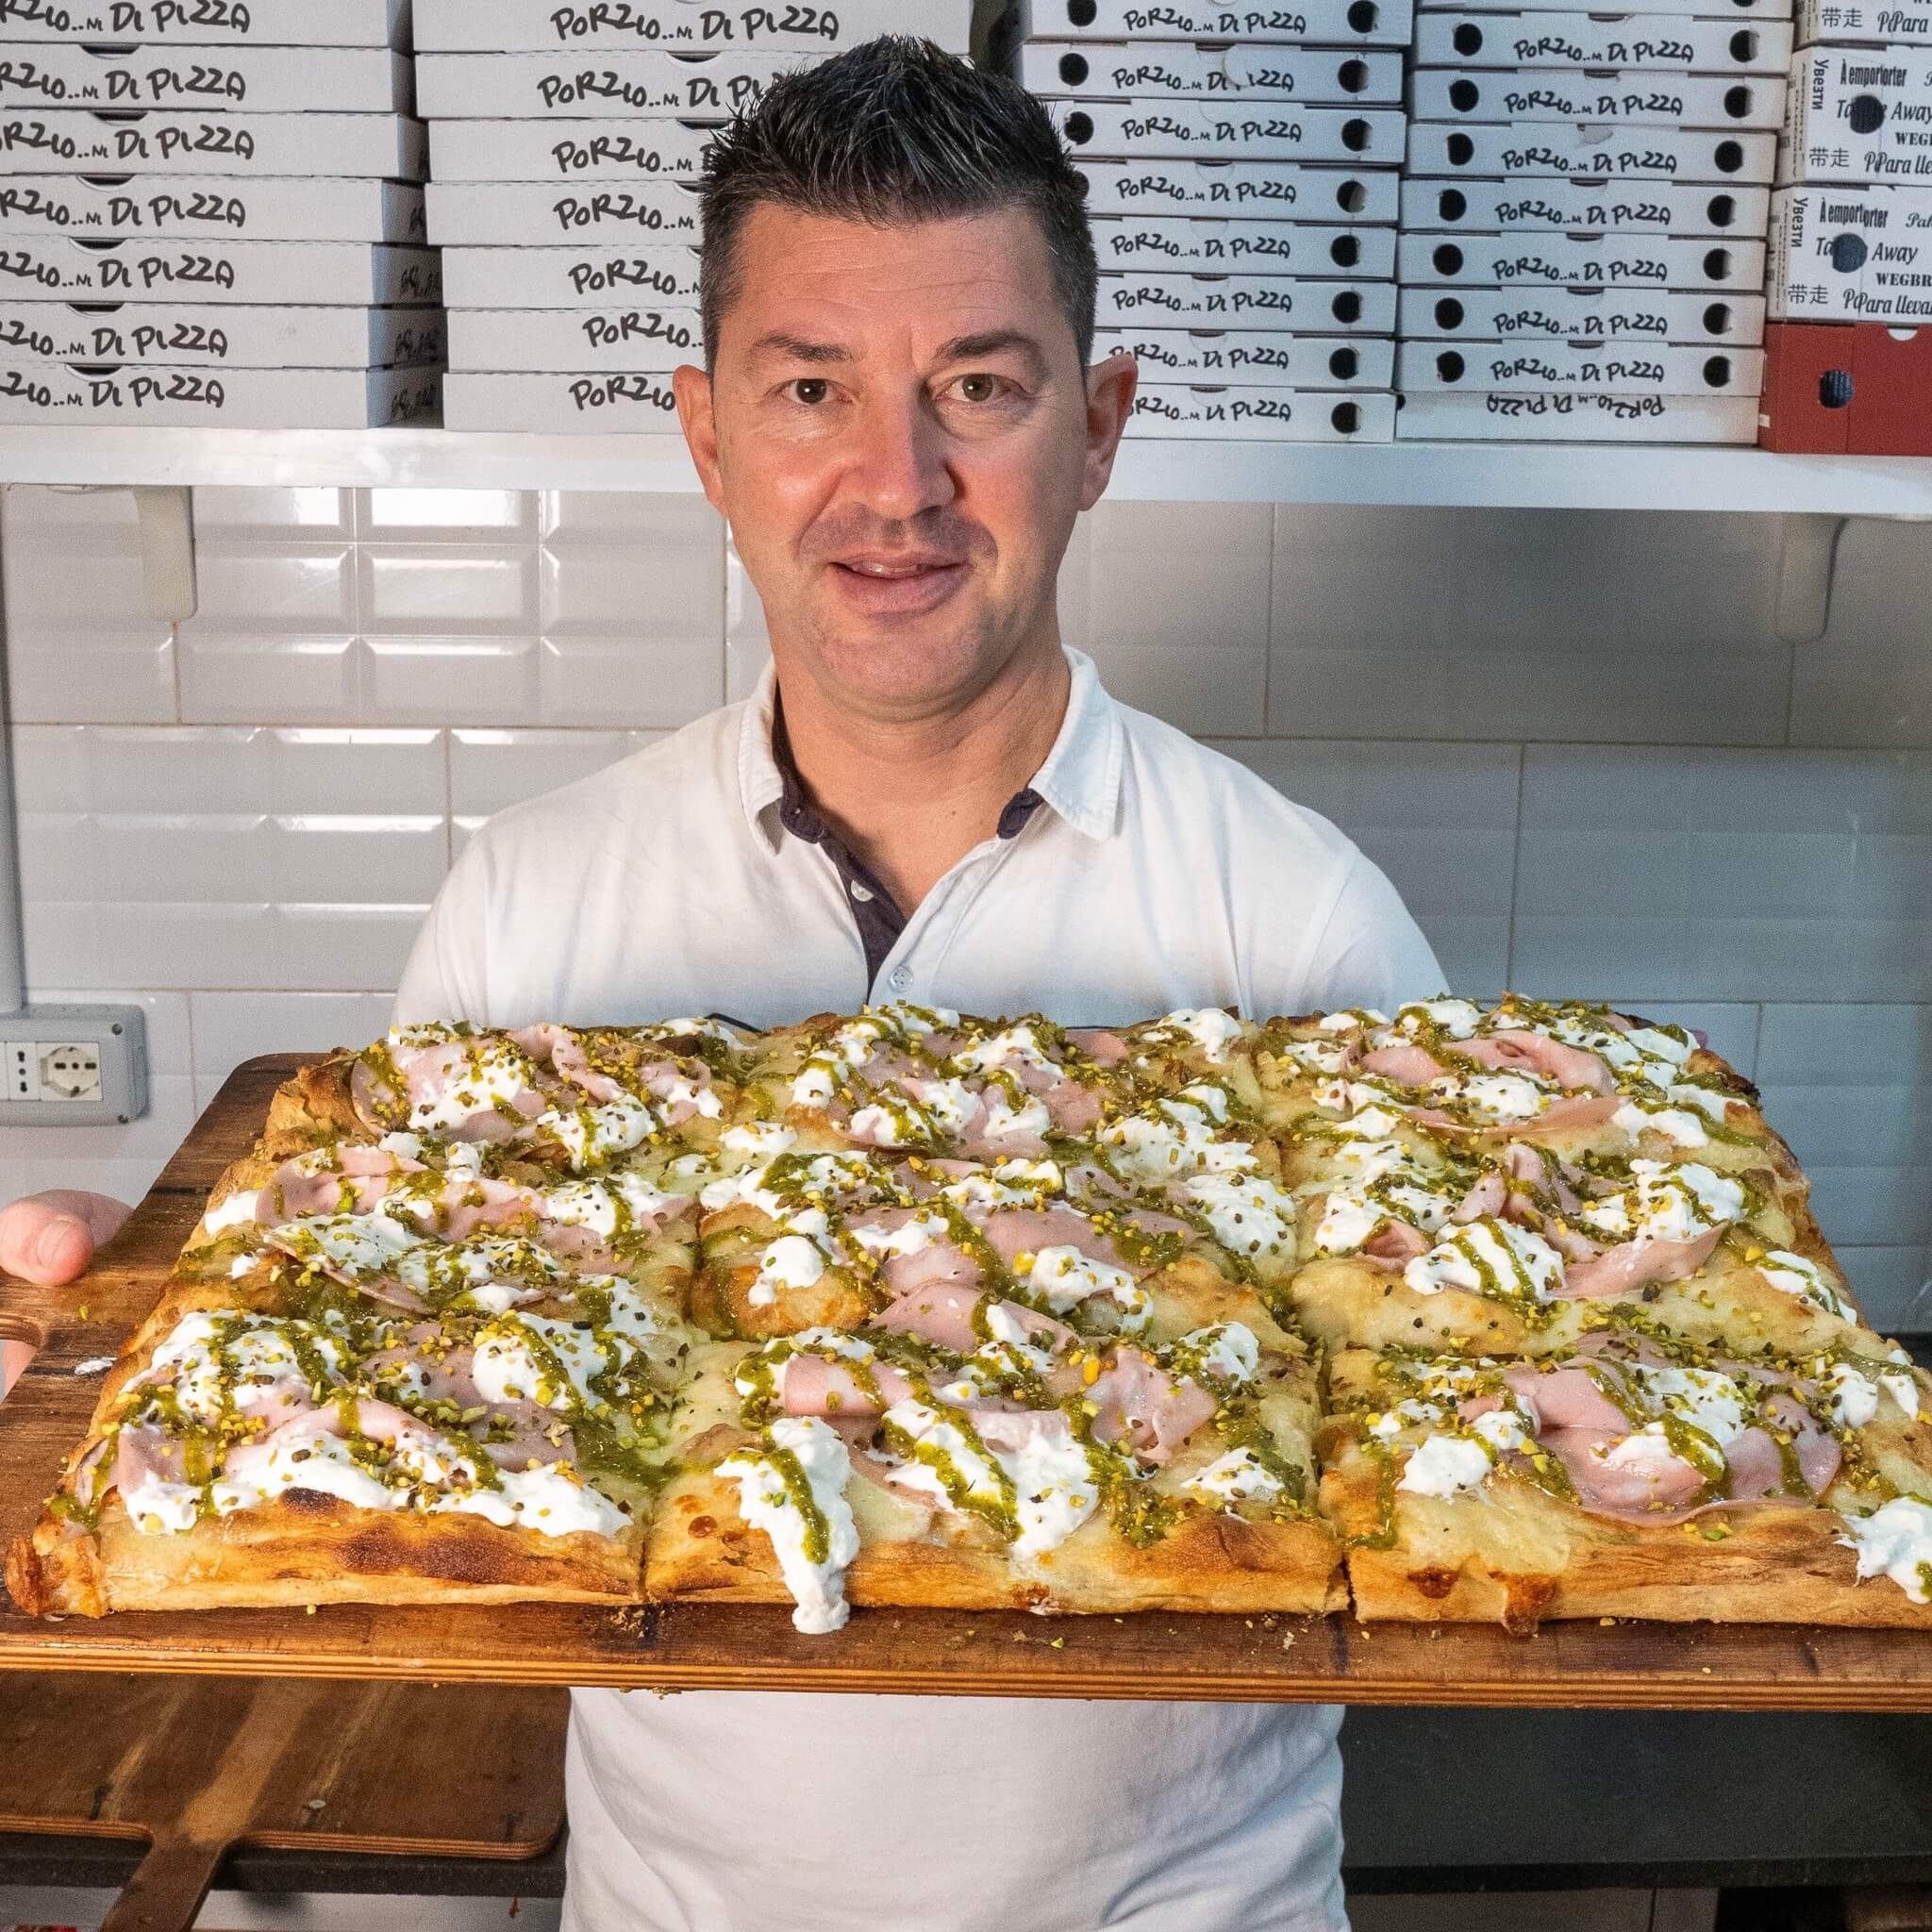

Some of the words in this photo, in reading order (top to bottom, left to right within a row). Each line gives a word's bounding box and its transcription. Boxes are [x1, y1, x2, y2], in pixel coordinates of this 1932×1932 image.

[109, 2, 144, 32] DI
[151, 0, 250, 33] PIZZA
[700, 10, 734, 41] DI
[741, 5, 839, 41] PIZZA
[1219, 13, 1240, 33] DI
[1244, 11, 1306, 34] PIZZA
[1822, 7, 1862, 28] 带走
[1607, 42, 1628, 61] DI
[1634, 40, 1693, 63] PIZZA
[105, 70, 141, 100] DI
[146, 65, 245, 101] PIZZA
[1234, 69, 1294, 92] IZZA
[1812, 59, 1829, 109] Увезти
[686, 77, 721, 108] DI
[1597, 95, 1617, 115] DI
[1623, 93, 1683, 116] PIZZA
[114, 129, 150, 158] DI
[155, 125, 254, 159] PIZZA
[1215, 122, 1237, 142] DI
[1241, 120, 1302, 142] PIZZA
[1592, 153, 1613, 173] DI
[1618, 151, 1677, 174] PIZZA
[1809, 146, 1849, 167] 带走
[1209, 183, 1230, 202] DI
[1236, 181, 1296, 204] PIZZA
[108, 197, 142, 226] DI
[148, 192, 245, 227] PIZZA
[1587, 206, 1607, 225] DI
[1611, 203, 1671, 225] PIZZA
[1790, 197, 1808, 248] Увезти
[1204, 239, 1225, 258] DI
[1229, 236, 1291, 258] PIZZA
[1872, 242, 1918, 265] Away
[97, 258, 132, 288] DI
[138, 255, 234, 289] PIZZA
[1583, 262, 1604, 281] DI
[1609, 259, 1667, 281] PIZZA
[1206, 294, 1227, 311] DI
[1233, 291, 1292, 313] PIZZA
[1788, 284, 1828, 304] 带走
[1584, 316, 1604, 335] DI
[1609, 313, 1668, 335] PIZZA
[92, 327, 125, 357] DI
[131, 324, 227, 358] PIZZA
[1228, 347, 1289, 370] PIZZA
[1581, 363, 1601, 381] DI
[1606, 360, 1664, 382] PIZZA
[89, 380, 123, 408] DI
[128, 375, 225, 408] PIZZA
[1231, 401, 1291, 422] PIZZA
